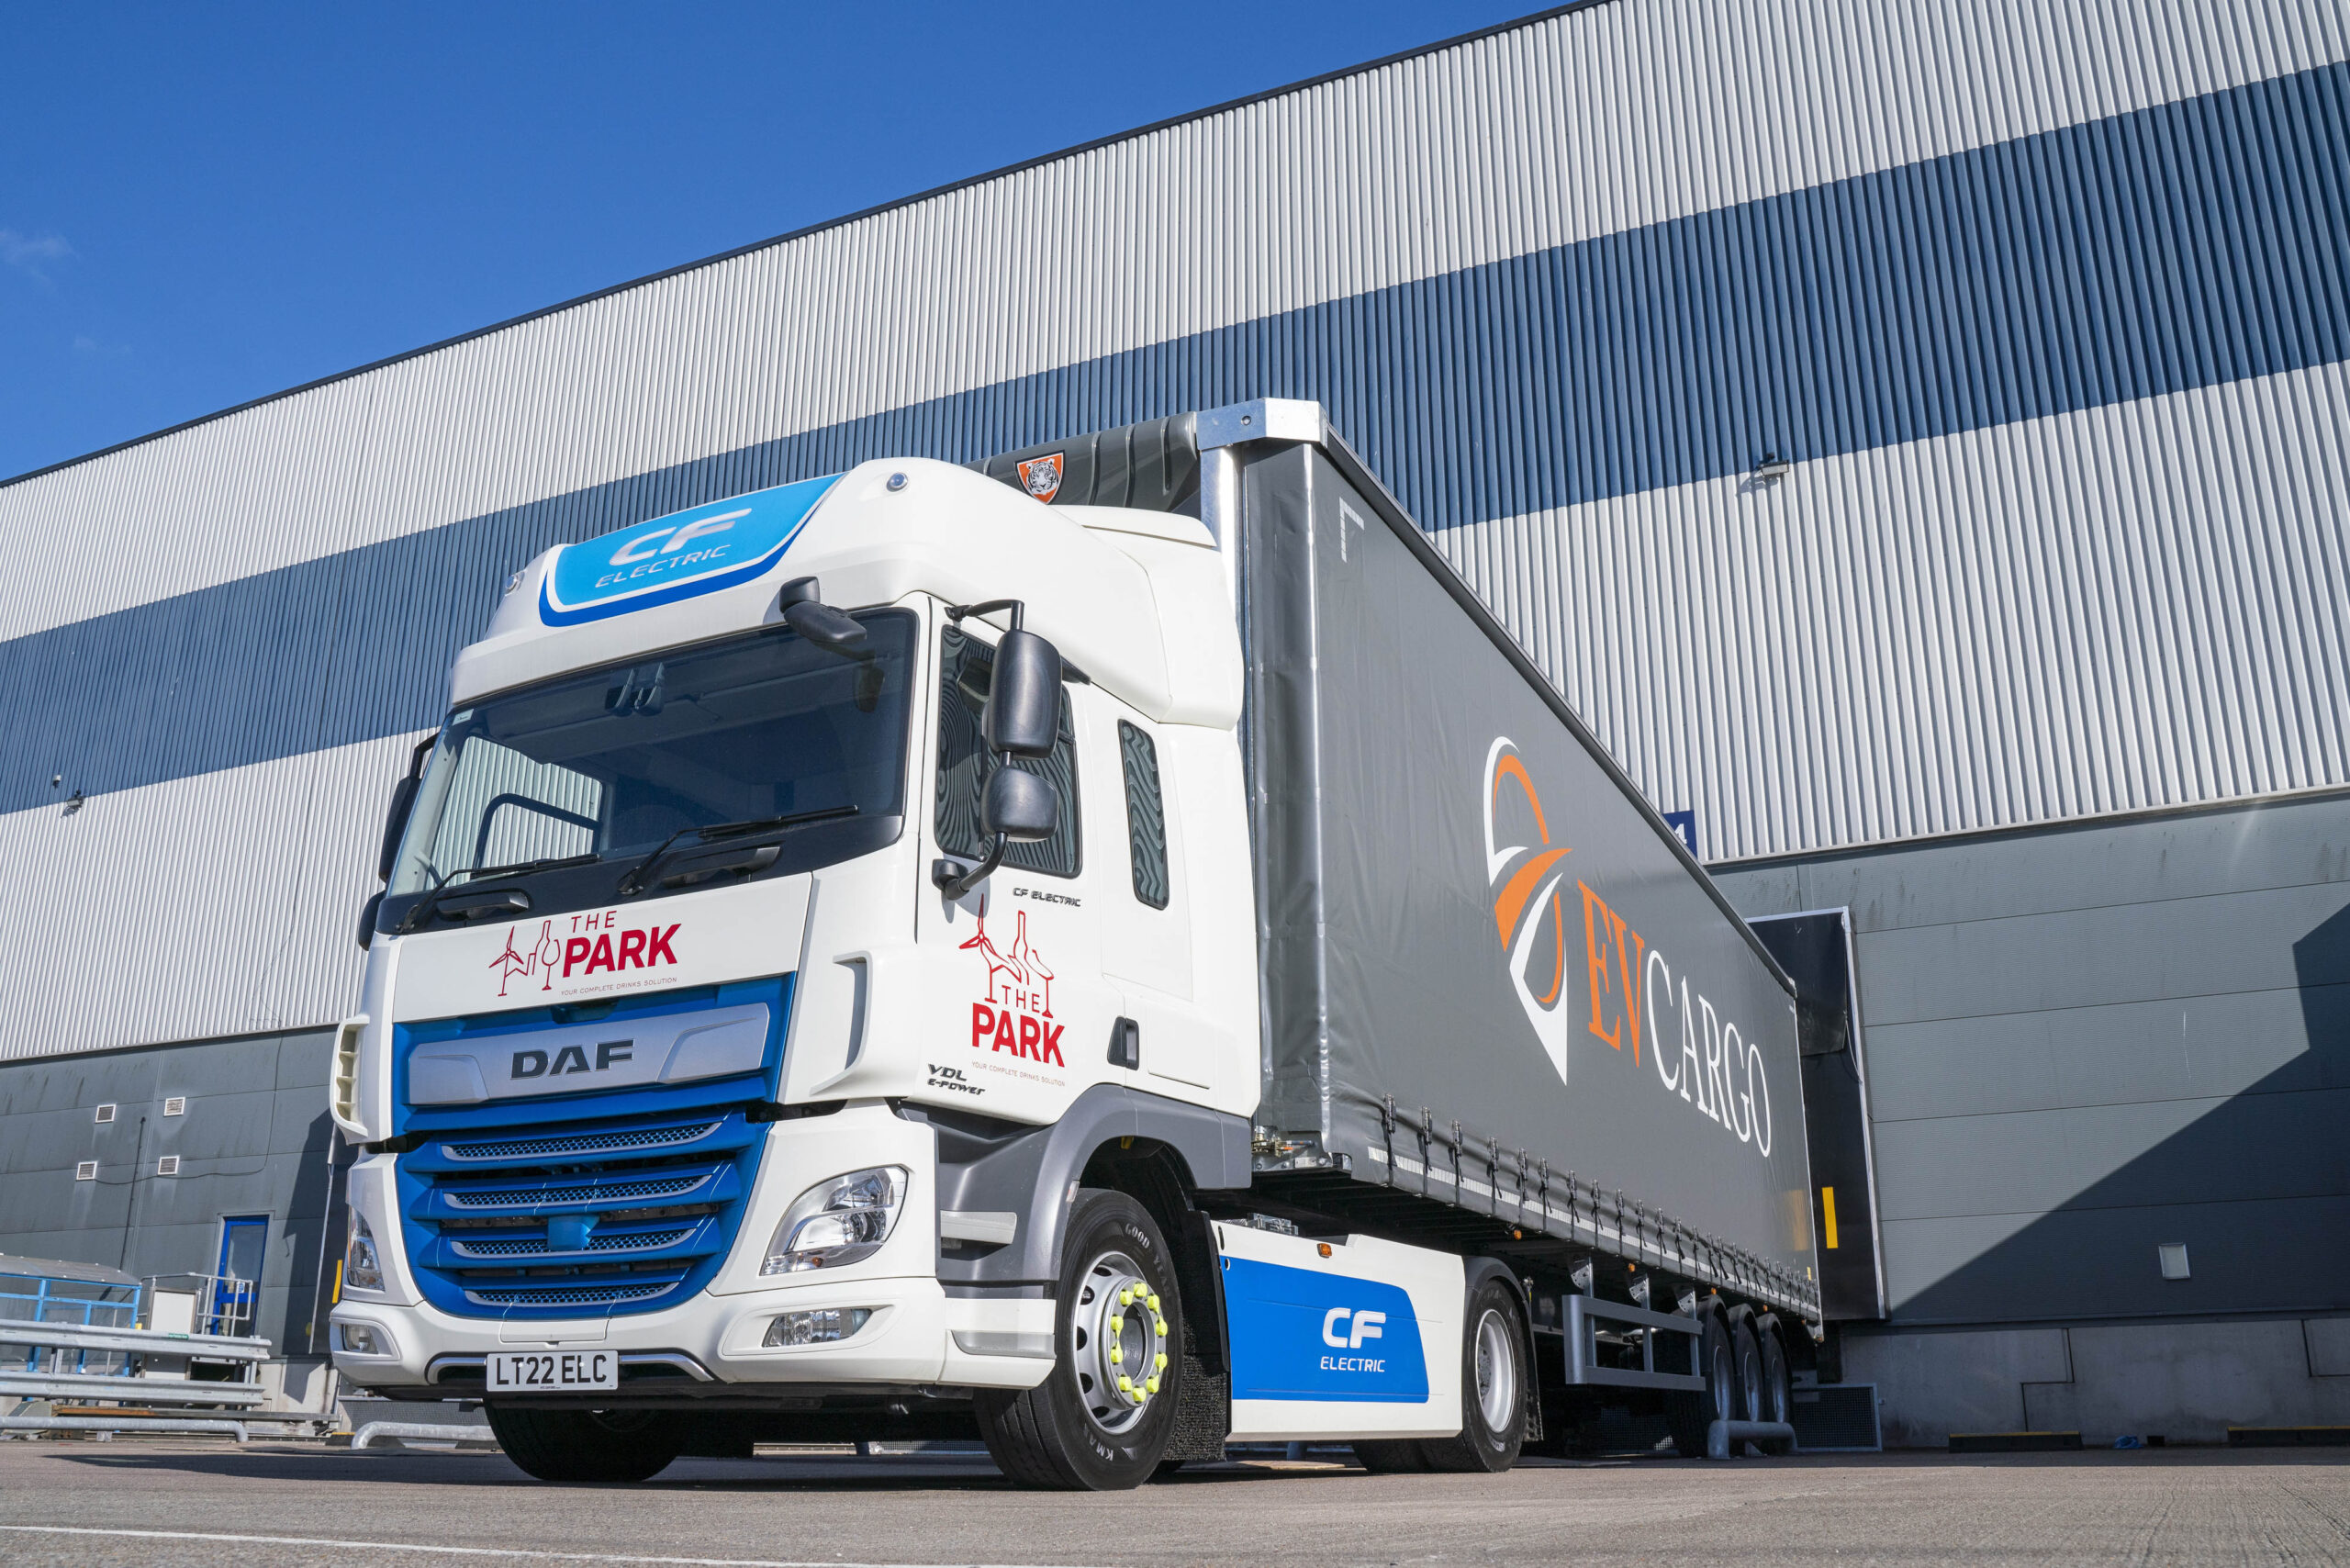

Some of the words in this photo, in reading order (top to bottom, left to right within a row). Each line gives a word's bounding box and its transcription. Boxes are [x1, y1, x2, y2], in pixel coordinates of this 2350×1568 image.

[609, 508, 753, 566] CF
[595, 543, 732, 588] ELECTRIC
[1013, 887, 1029, 897] CF
[1031, 890, 1081, 907] ELECTRIC
[571, 910, 617, 934] THE
[562, 923, 682, 979] PARK
[579, 984, 613, 994] COMPLETE
[616, 980, 641, 990] DRINKS
[643, 977, 677, 986] SOLUTION
[1002, 984, 1040, 1014] THE
[971, 1002, 1066, 1068] PARK
[509, 1038, 635, 1081] DAF
[927, 1063, 967, 1081] VDL
[971, 1060, 987, 1071] YOUR
[989, 1065, 1018, 1077] COMPLETE
[1019, 1071, 1040, 1081] DRINKS
[1041, 1076, 1065, 1087] SOLUTION
[1322, 1307, 1386, 1349] CF
[496, 1356, 554, 1385] LT22
[561, 1354, 607, 1383] ELC
[1320, 1356, 1385, 1372] ELECTRIC
